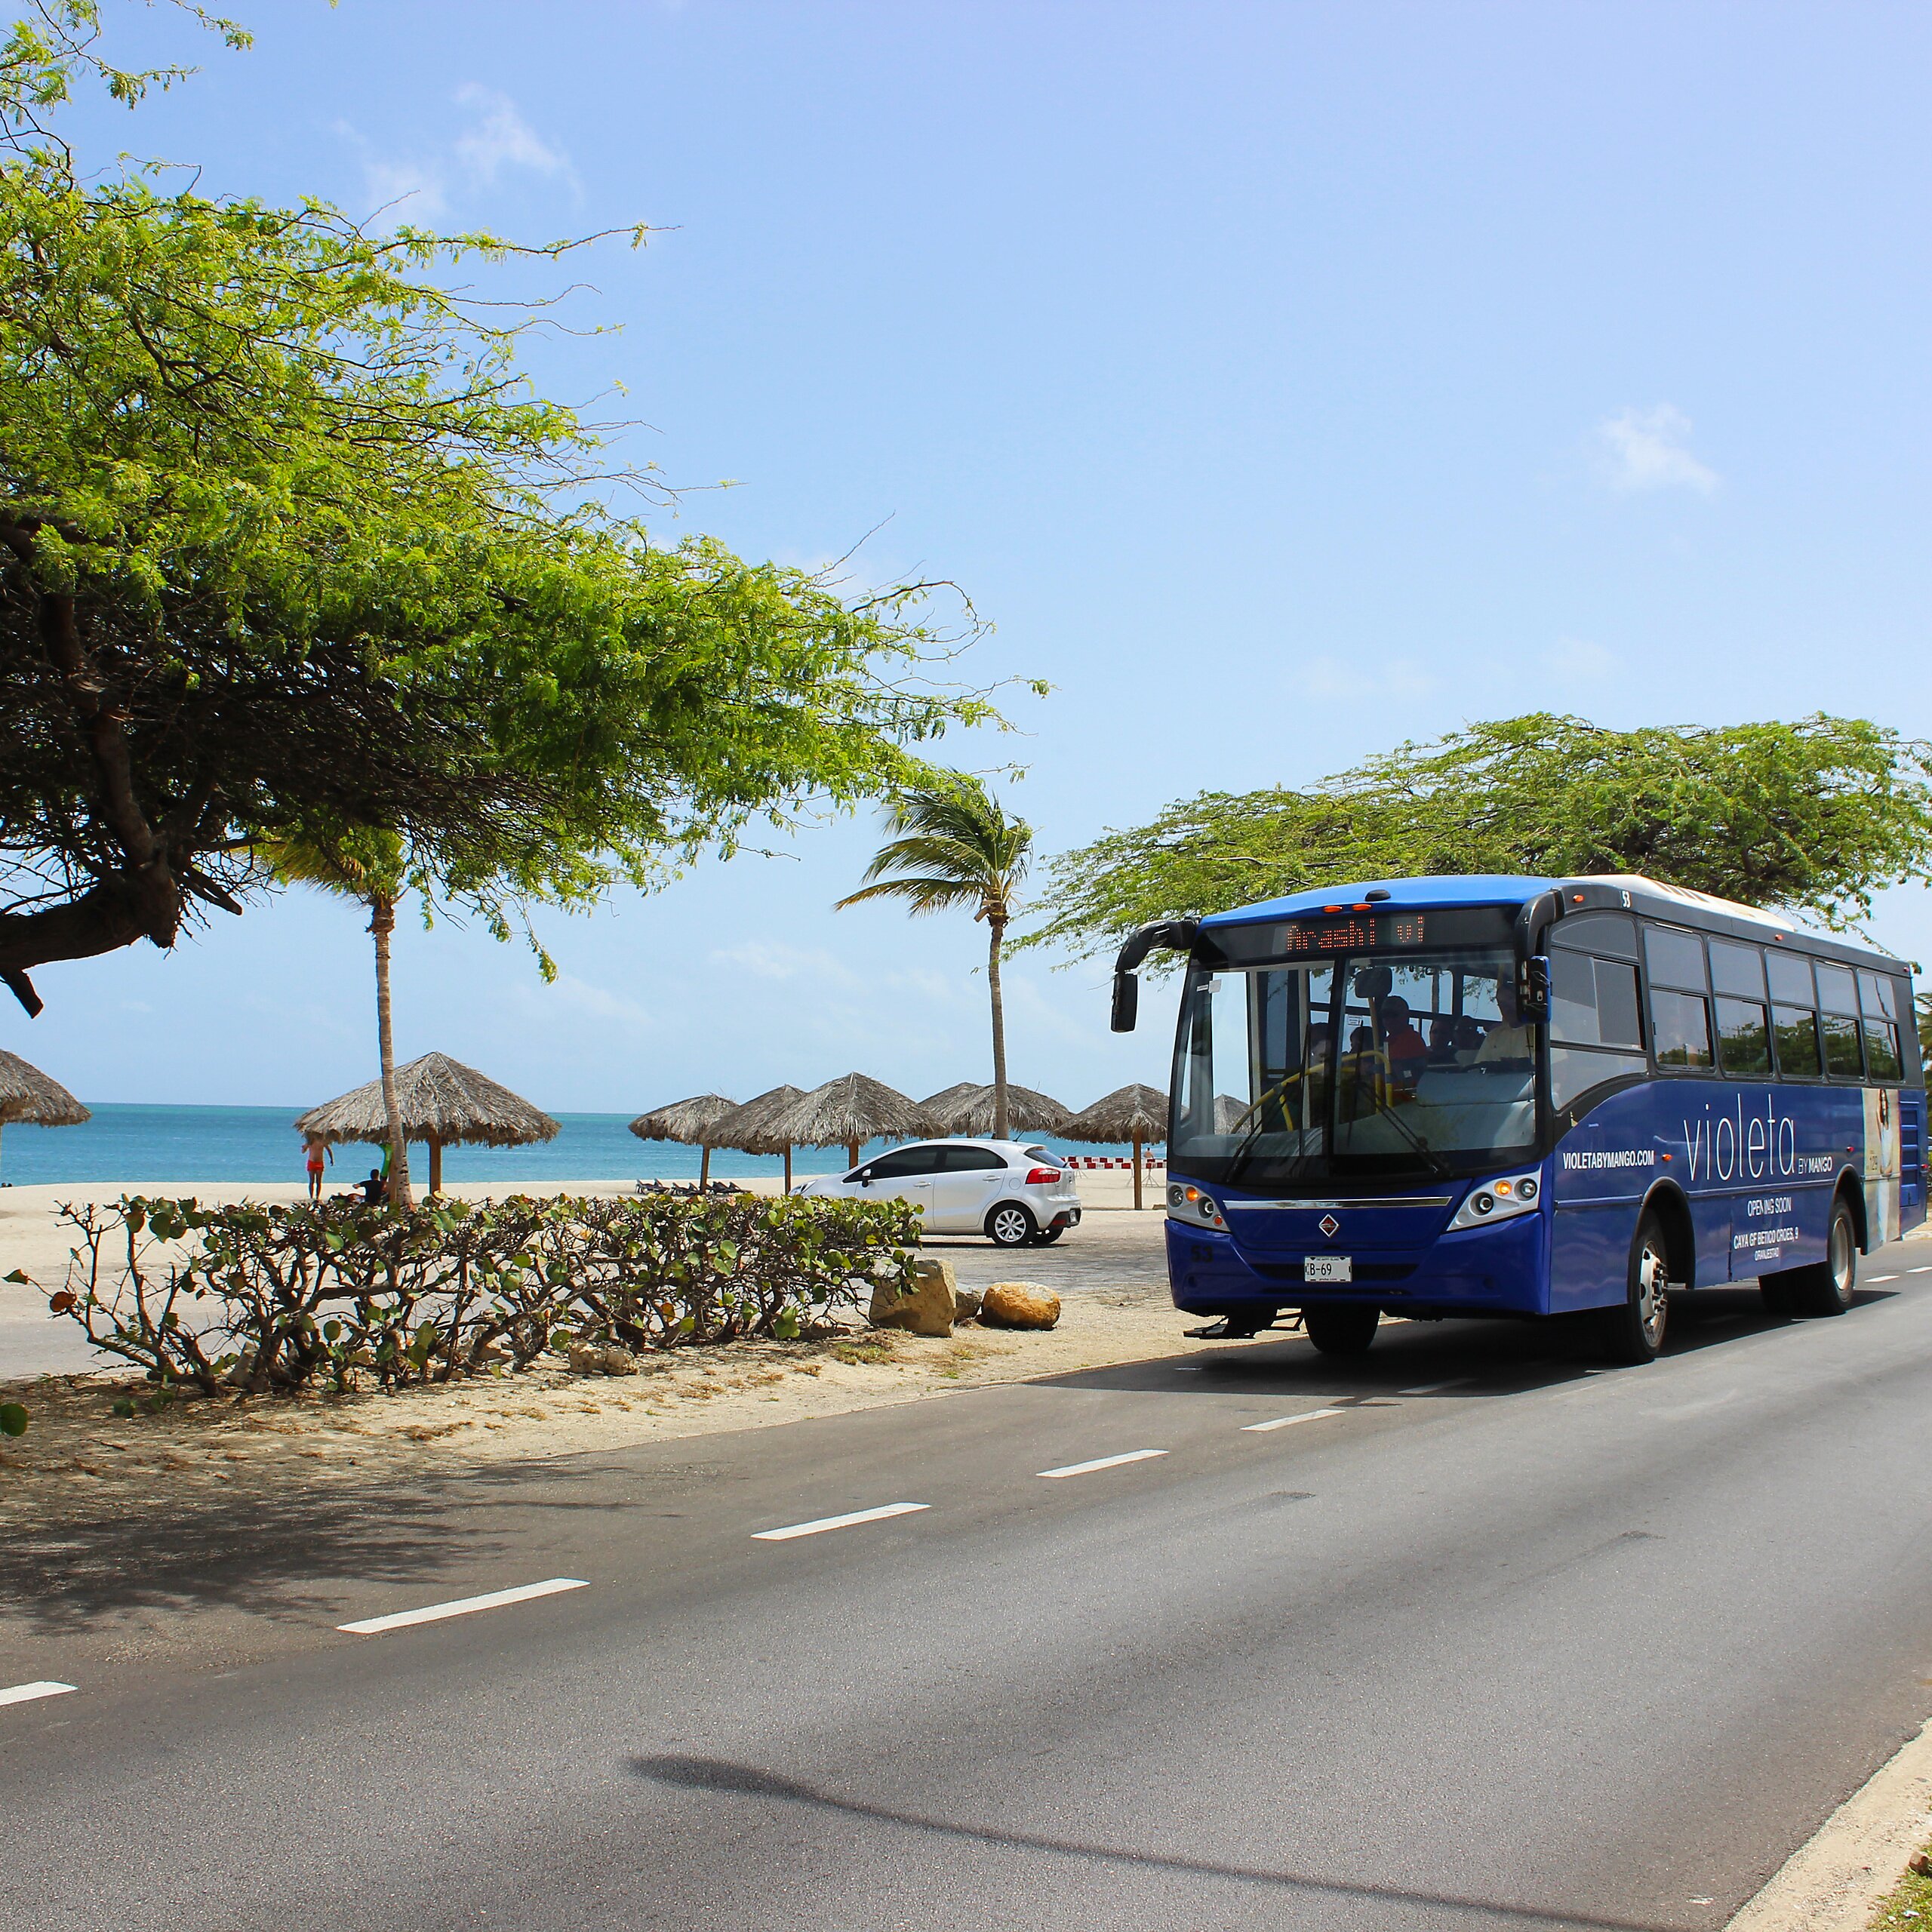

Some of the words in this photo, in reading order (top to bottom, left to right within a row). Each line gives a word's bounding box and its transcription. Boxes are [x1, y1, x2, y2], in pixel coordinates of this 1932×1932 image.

[1287, 918, 1376, 950] Arashi
[1683, 1093, 1795, 1182] violeta
[1798, 1158, 1808, 1174] BY
[1808, 1155, 1833, 1174] MANGO
[1562, 1149, 1655, 1170] VIOLETABYMANGO.COM
[1747, 1198, 1774, 1217] OPENING
[1774, 1196, 1792, 1214] SOON
[1734, 1232, 1749, 1250] CAYA
[1749, 1232, 1757, 1247] GF
[1757, 1229, 1776, 1245] BETICO
[1794, 1226, 1799, 1239] 9
[1191, 1244, 1214, 1263] 53
[1309, 1263, 1332, 1275] B-69
